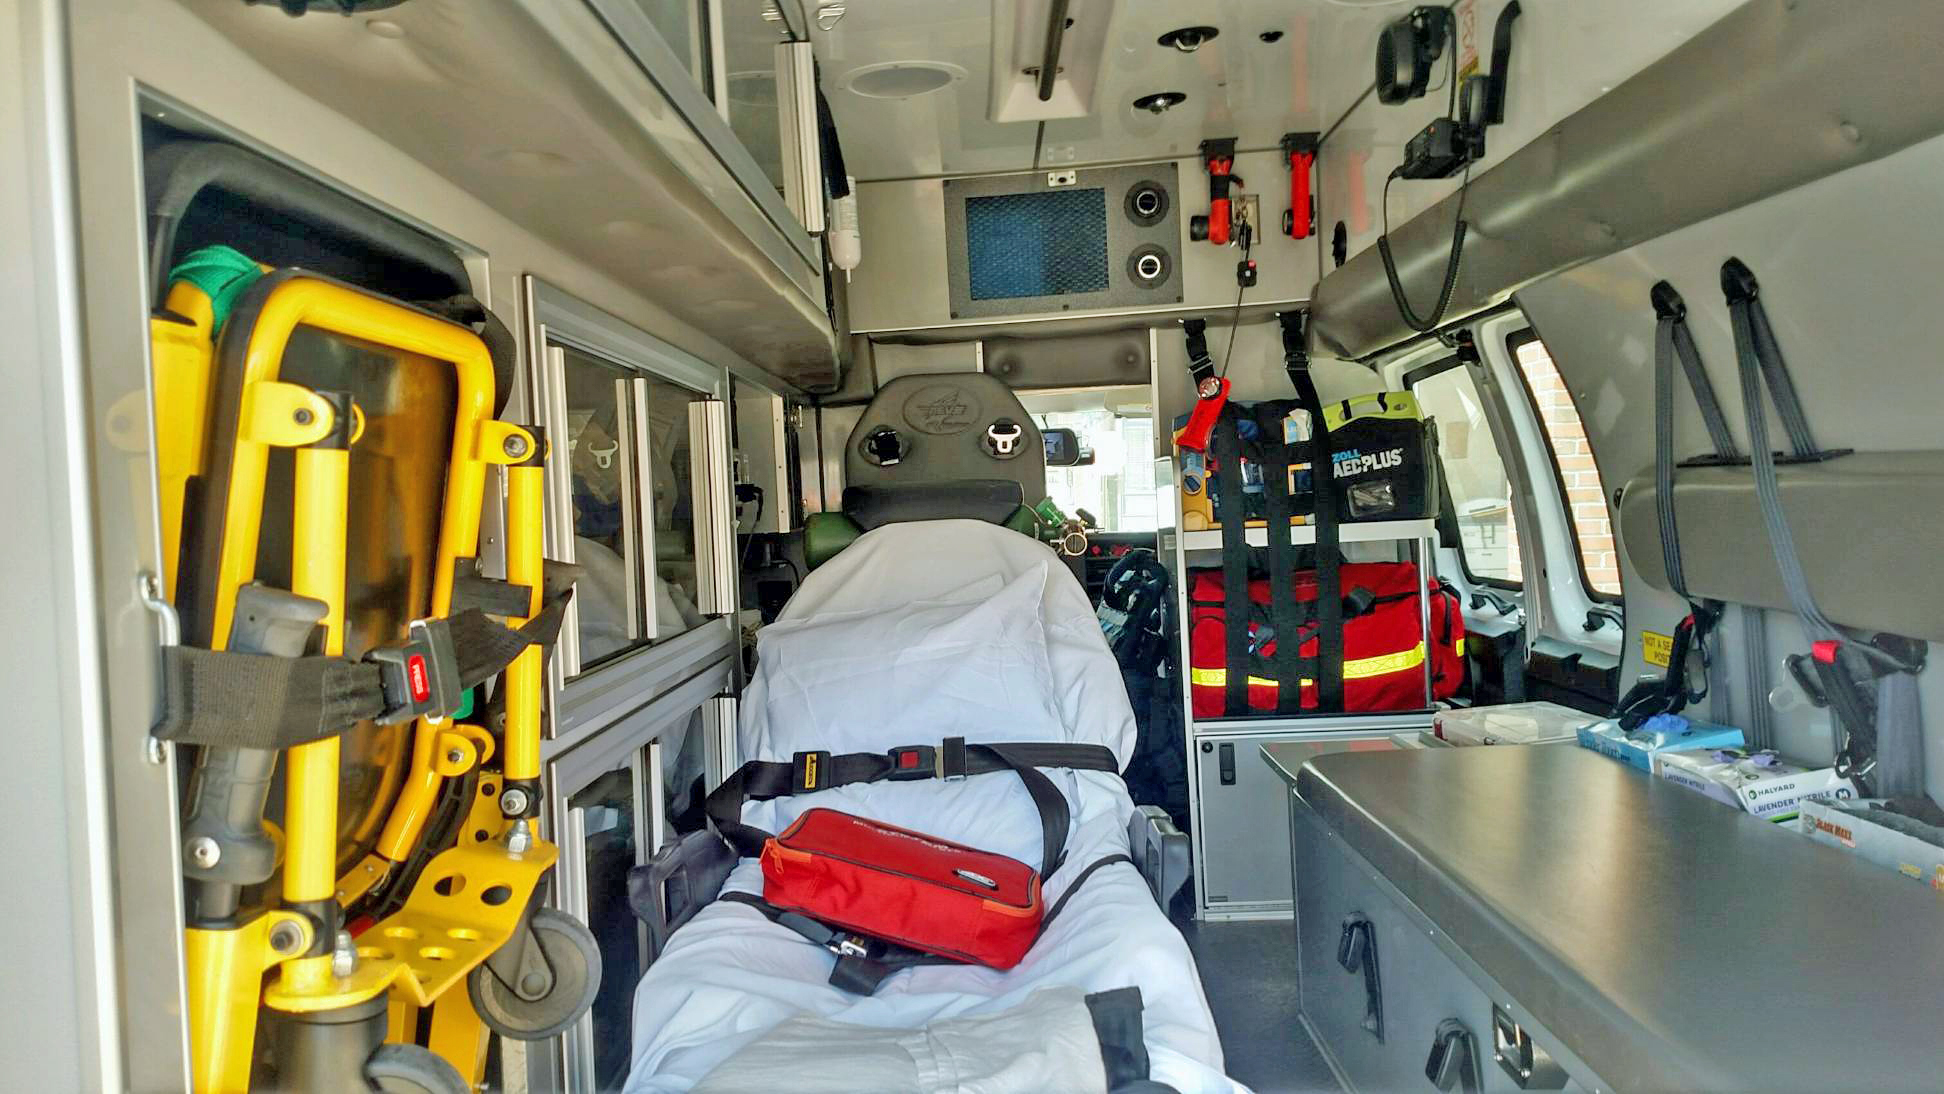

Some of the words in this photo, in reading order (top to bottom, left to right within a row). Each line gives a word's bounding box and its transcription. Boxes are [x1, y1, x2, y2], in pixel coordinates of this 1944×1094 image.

[1331, 449, 1361, 463] ZOLL
[1758, 783, 1795, 796] HALYARD
[1754, 798, 1794, 814] LAVENDER
